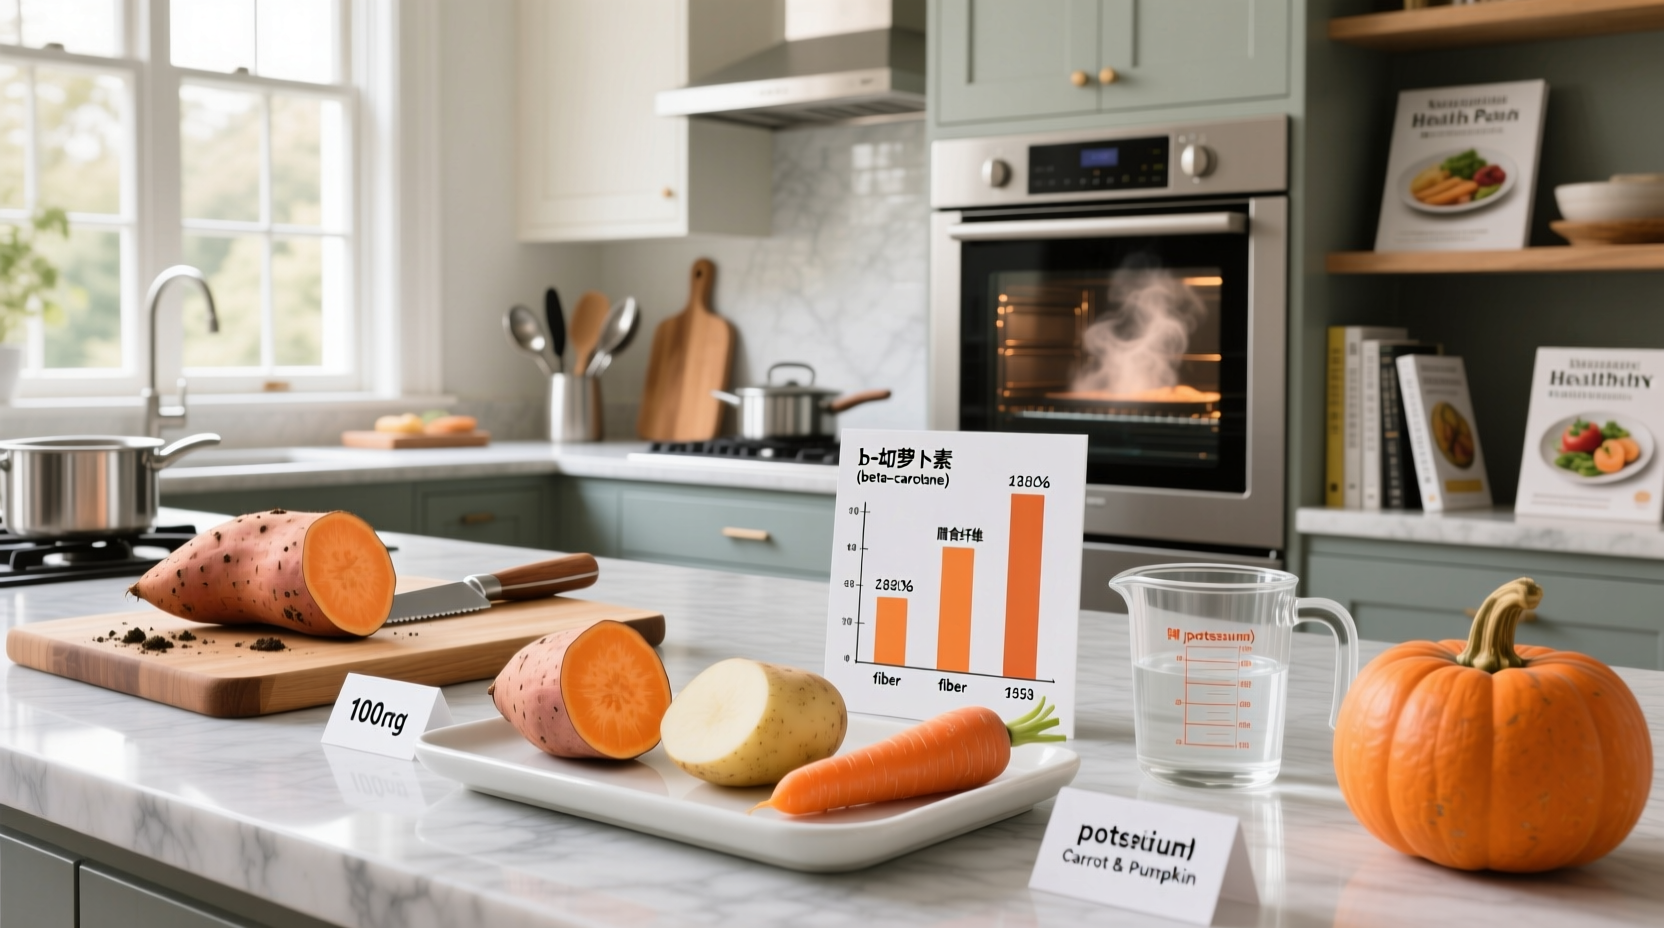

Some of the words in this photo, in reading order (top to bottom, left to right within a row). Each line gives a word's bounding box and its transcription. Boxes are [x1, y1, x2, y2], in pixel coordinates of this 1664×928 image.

[873, 671, 902, 687] fiber
[1062, 849, 1108, 870] Carrot
[1112, 857, 1123, 872] &
